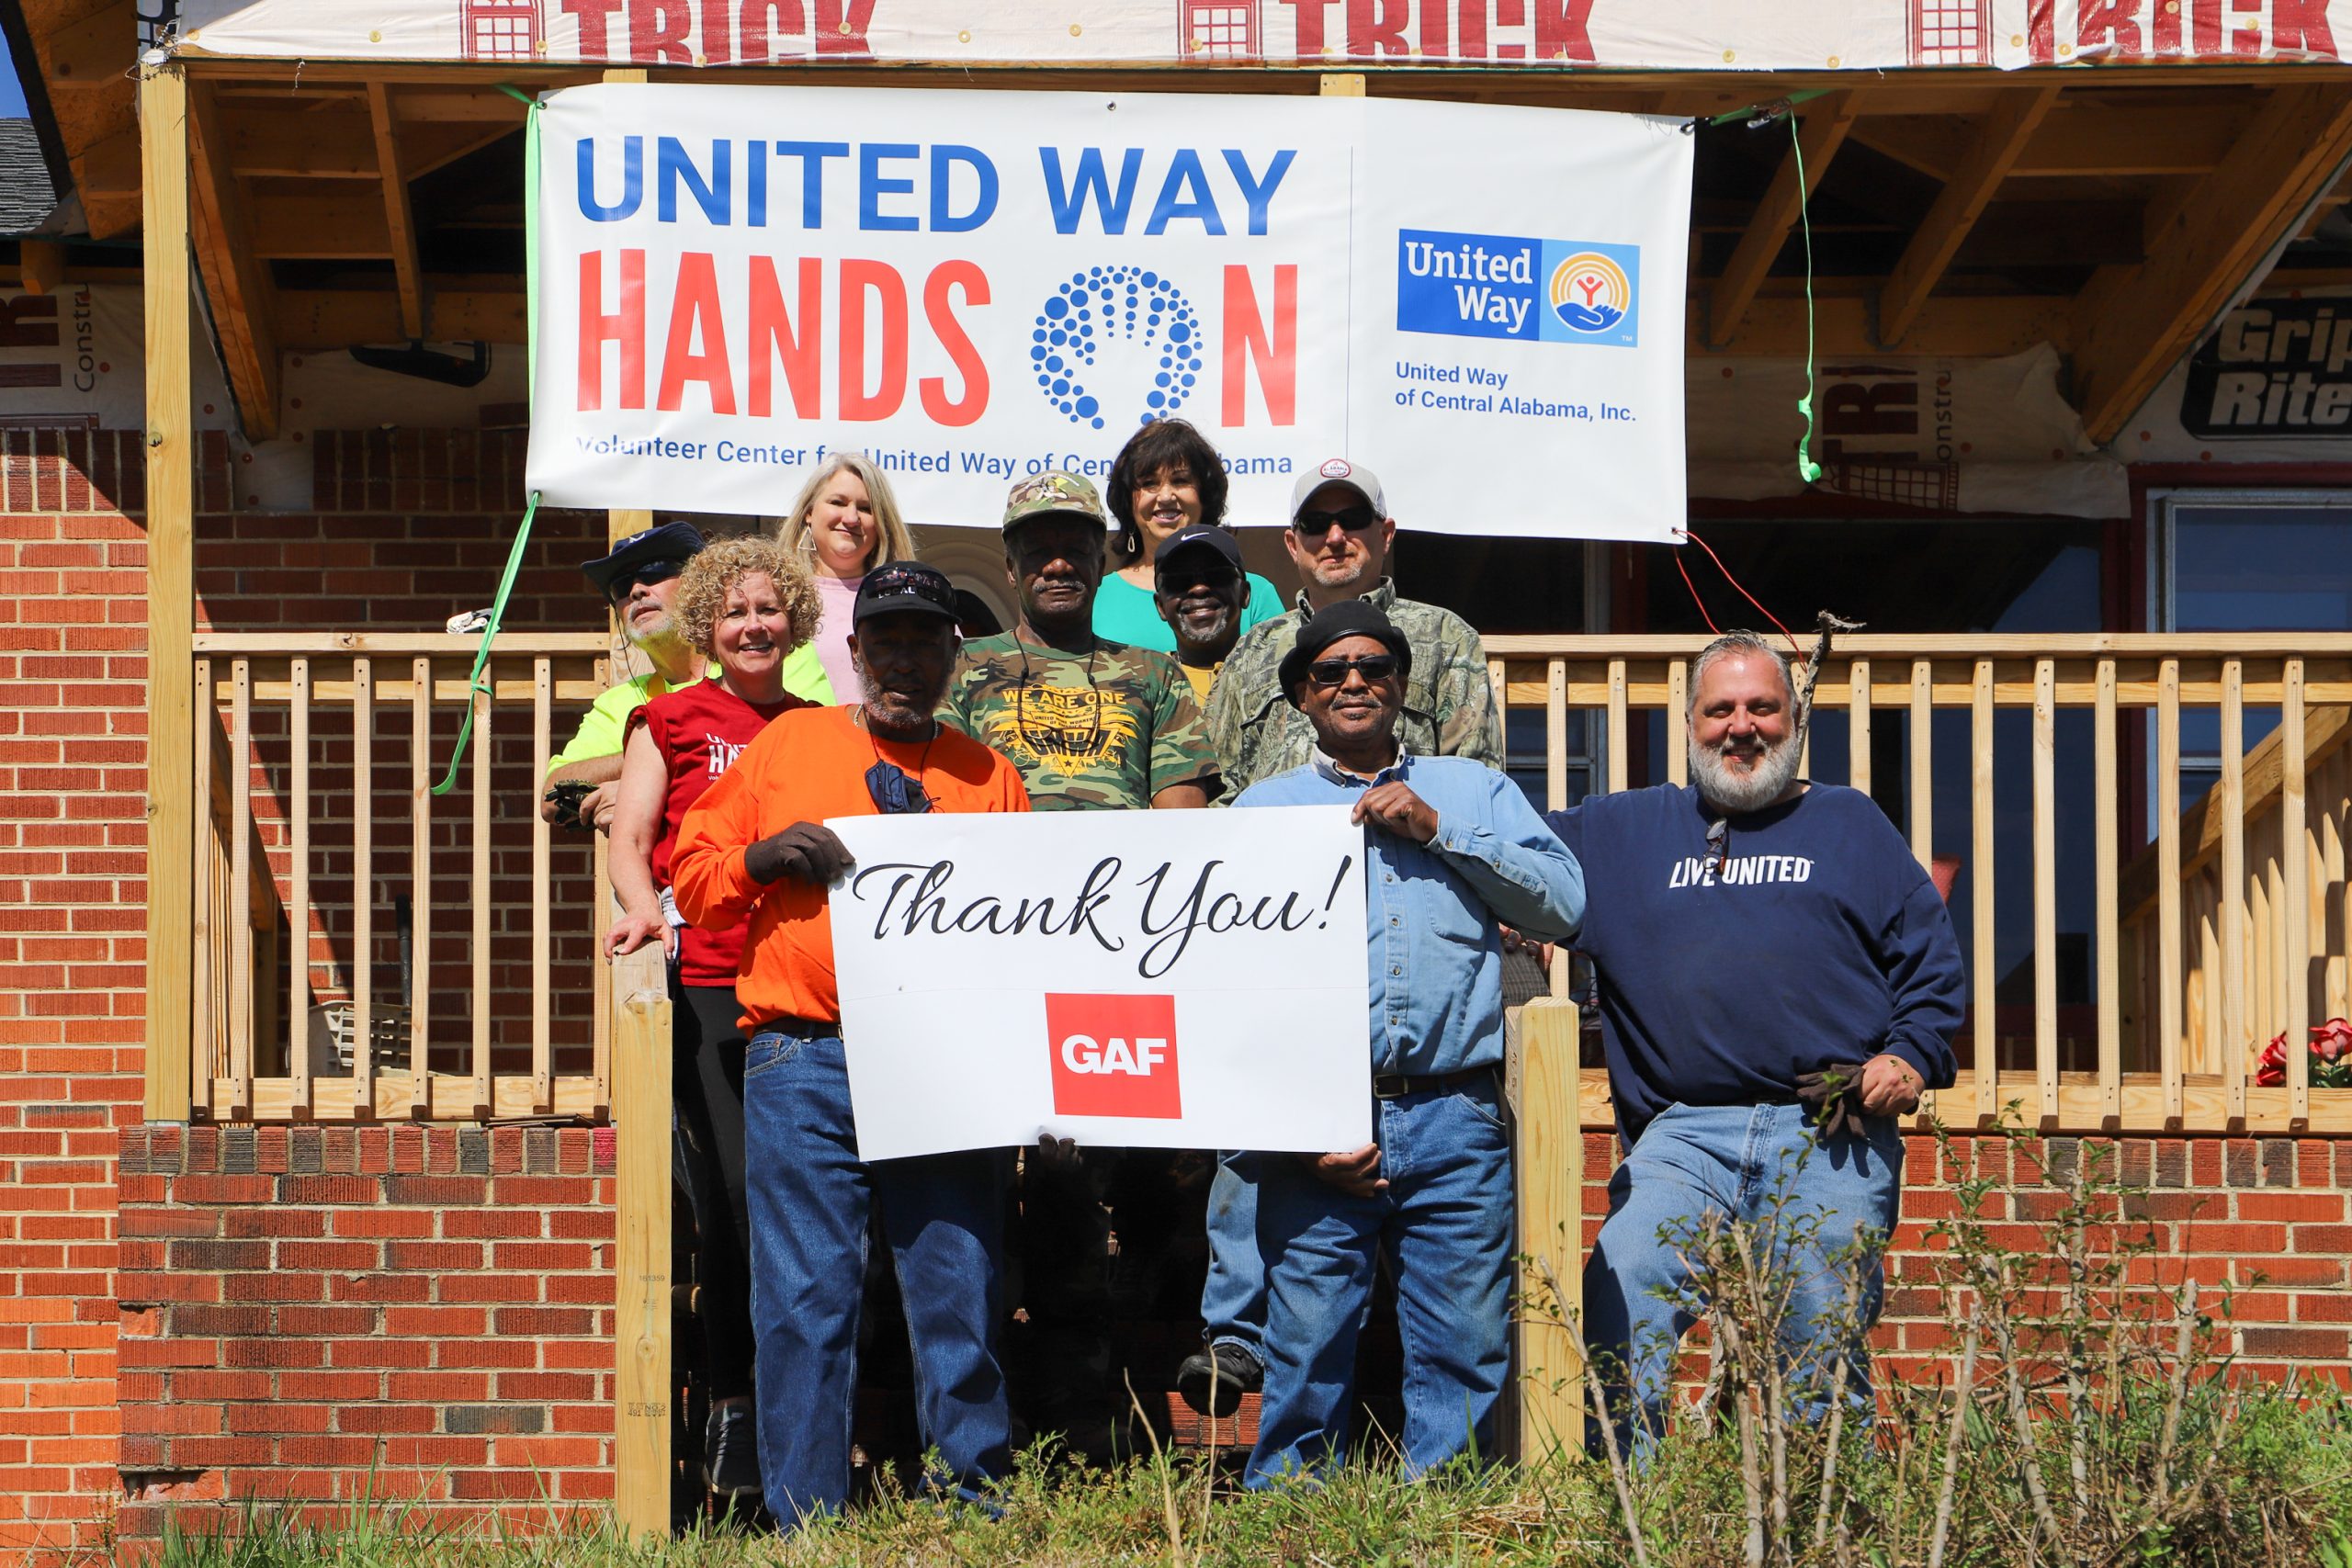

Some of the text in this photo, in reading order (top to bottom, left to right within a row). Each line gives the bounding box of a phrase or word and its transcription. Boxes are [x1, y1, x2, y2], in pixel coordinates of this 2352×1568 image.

[577, 136, 1297, 235] UNITED WAY
[1406, 242, 1532, 284] United
[1454, 285, 1532, 333] Way
[578, 249, 990, 427] HANDS
[2218, 309, 2352, 372] Grip
[1396, 361, 1508, 390] United Way
[1396, 389, 1637, 422] of Central Alabama, Inc.
[2209, 372, 2352, 425] Rite
[576, 434, 707, 459] Volunteer
[717, 440, 806, 465] Center
[961, 453, 1015, 479] Way
[1026, 453, 1054, 475] of
[1002, 691, 1126, 708] WE ARE ONE
[1668, 855, 1812, 888] LIVE UNITED
[852, 854, 1353, 979] Thank You!
[1061, 1034, 1167, 1077] GAF
